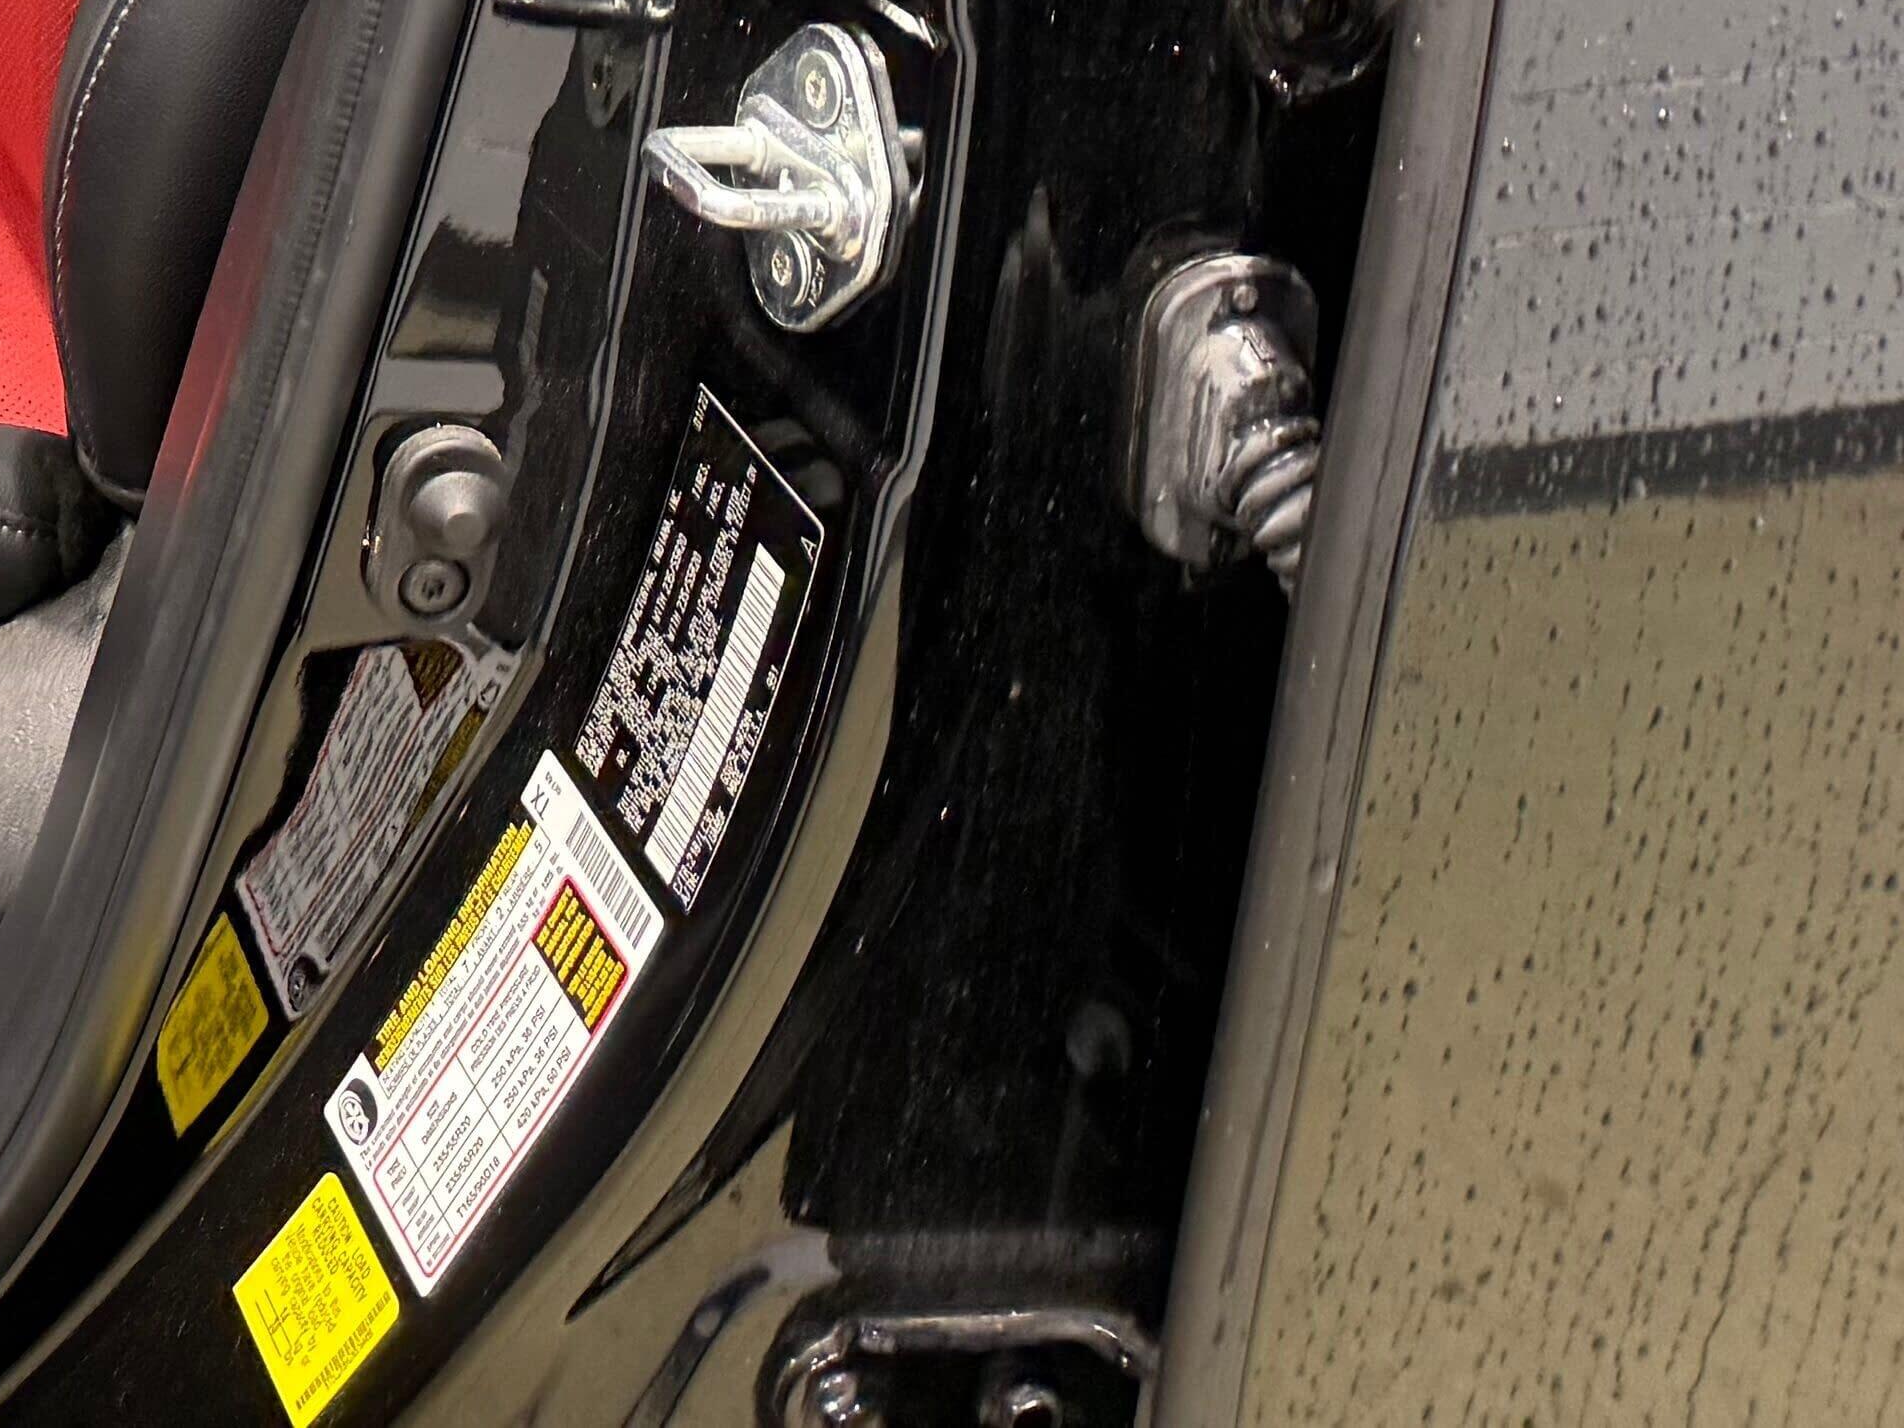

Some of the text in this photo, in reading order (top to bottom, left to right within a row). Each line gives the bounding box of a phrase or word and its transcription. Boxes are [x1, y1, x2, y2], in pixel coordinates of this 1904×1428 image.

[797, 529, 818, 561] A
[528, 783, 553, 820] TX
[375, 1006, 401, 1049] TIRE
[396, 976, 422, 1017] AND
[417, 915, 461, 987] LOADING
[455, 820, 520, 923] INFORMATION
[490, 1063, 508, 1090] 250
[530, 1002, 546, 1029] PSI
[555, 1043, 572, 1071] PSI
[502, 1083, 520, 1111] 250
[541, 1022, 559, 1050] PSI
[349, 1245, 373, 1282] LOAD
